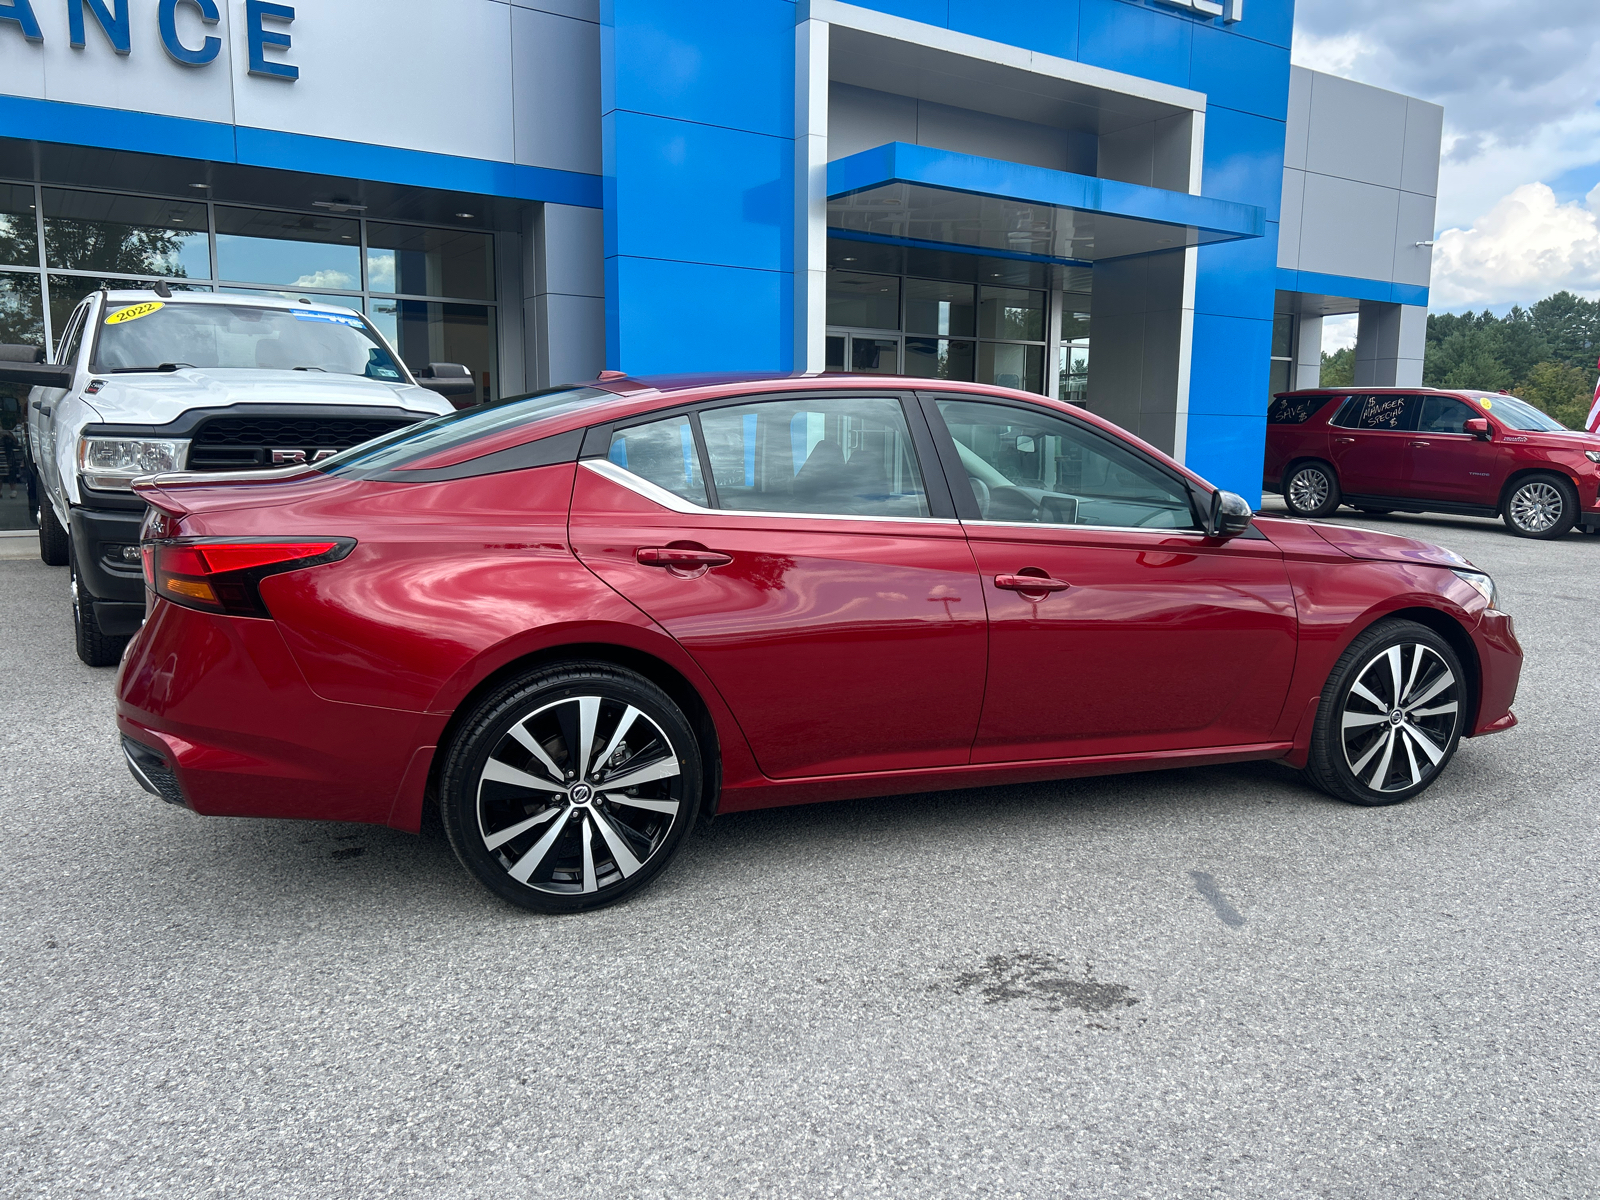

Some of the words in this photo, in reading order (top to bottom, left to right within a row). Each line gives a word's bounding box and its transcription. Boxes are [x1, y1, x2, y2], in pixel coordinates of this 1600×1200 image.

[116, 303, 155, 321] 2022
[1363, 397, 1405, 420] MANAGER
[1367, 406, 1403, 427] SPECIAL
